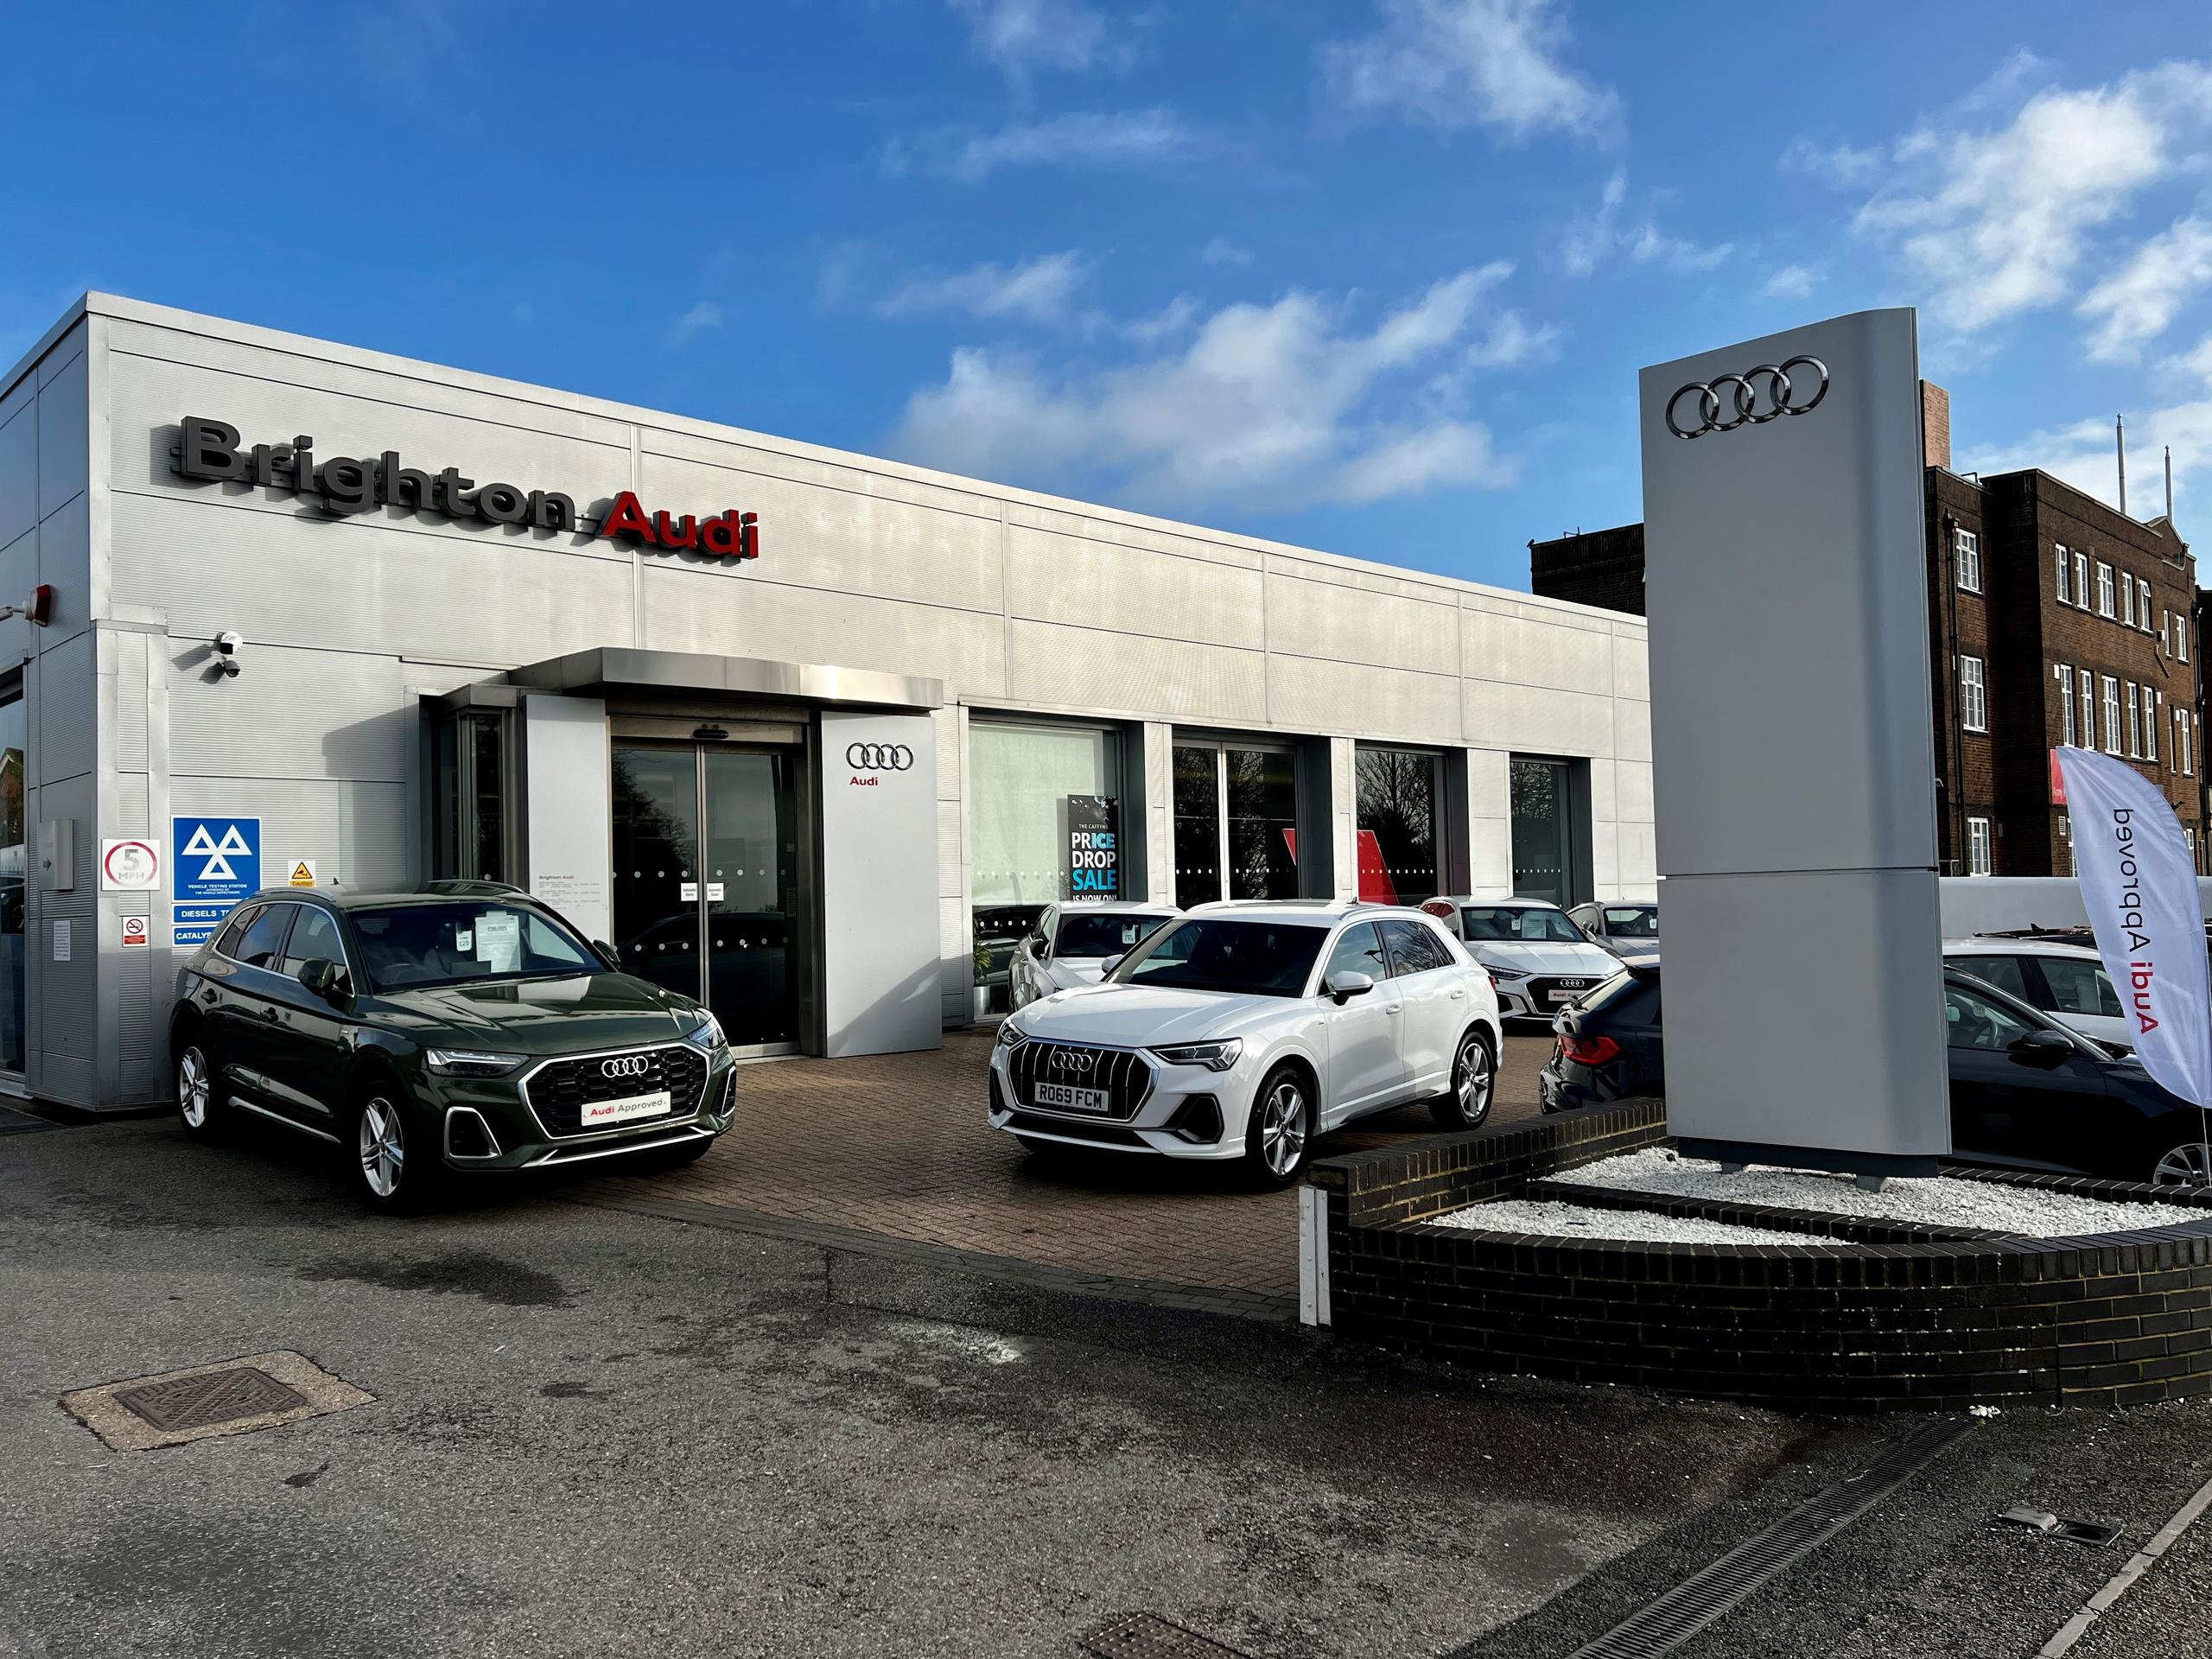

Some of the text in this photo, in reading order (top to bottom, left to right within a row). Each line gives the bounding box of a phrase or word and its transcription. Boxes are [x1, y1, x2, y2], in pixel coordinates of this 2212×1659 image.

[181, 416, 759, 560] Brighton Audi
[849, 776, 878, 785] Audi
[1071, 832, 1116, 849] PRICE
[123, 849, 140, 871] 5
[1072, 850, 1116, 868] DROP
[1072, 869, 1117, 891] SALE
[1039, 1084, 1103, 1109] RO69 FCM
[590, 1098, 663, 1116] Audi Approved
